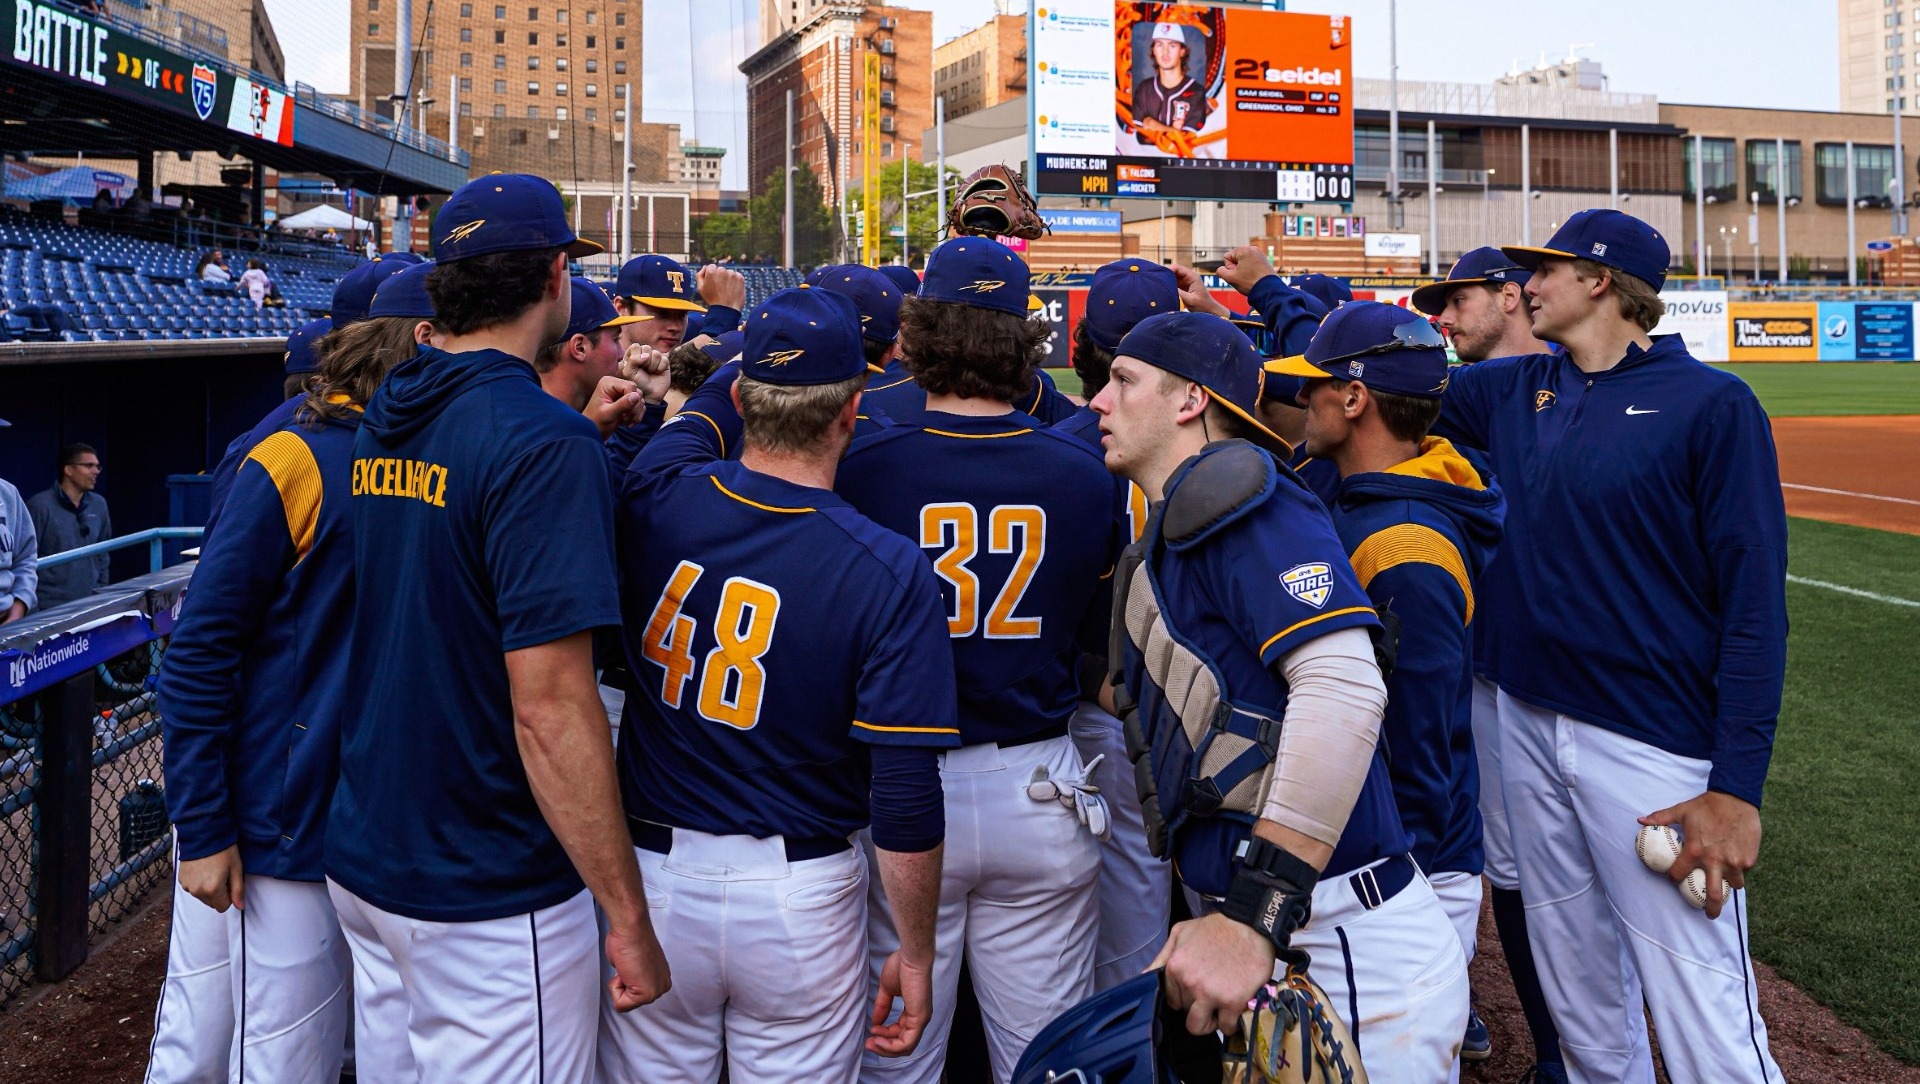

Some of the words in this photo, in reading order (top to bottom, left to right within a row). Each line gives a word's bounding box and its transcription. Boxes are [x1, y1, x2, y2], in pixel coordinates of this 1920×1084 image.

[13, 0, 109, 86] BATTLE
[144, 58, 160, 89] OF
[1234, 58, 1270, 81] 21
[1265, 66, 1342, 86] seidel
[196, 82, 211, 108] 75
[1046, 157, 1107, 170] MUDHENS.COM
[1130, 169, 1155, 178] FALCONS
[1082, 176, 1108, 193] MPH
[1130, 184, 1156, 193] ROCKETS
[1040, 216, 1070, 226] LADE
[667, 271, 684, 294] T
[1735, 319, 1763, 334] The
[1736, 331, 1812, 347] Andersons
[920, 502, 1047, 640] 32
[1288, 574, 1333, 596] MAC
[27, 636, 90, 675] Nationwide
[641, 559, 781, 731] 48
